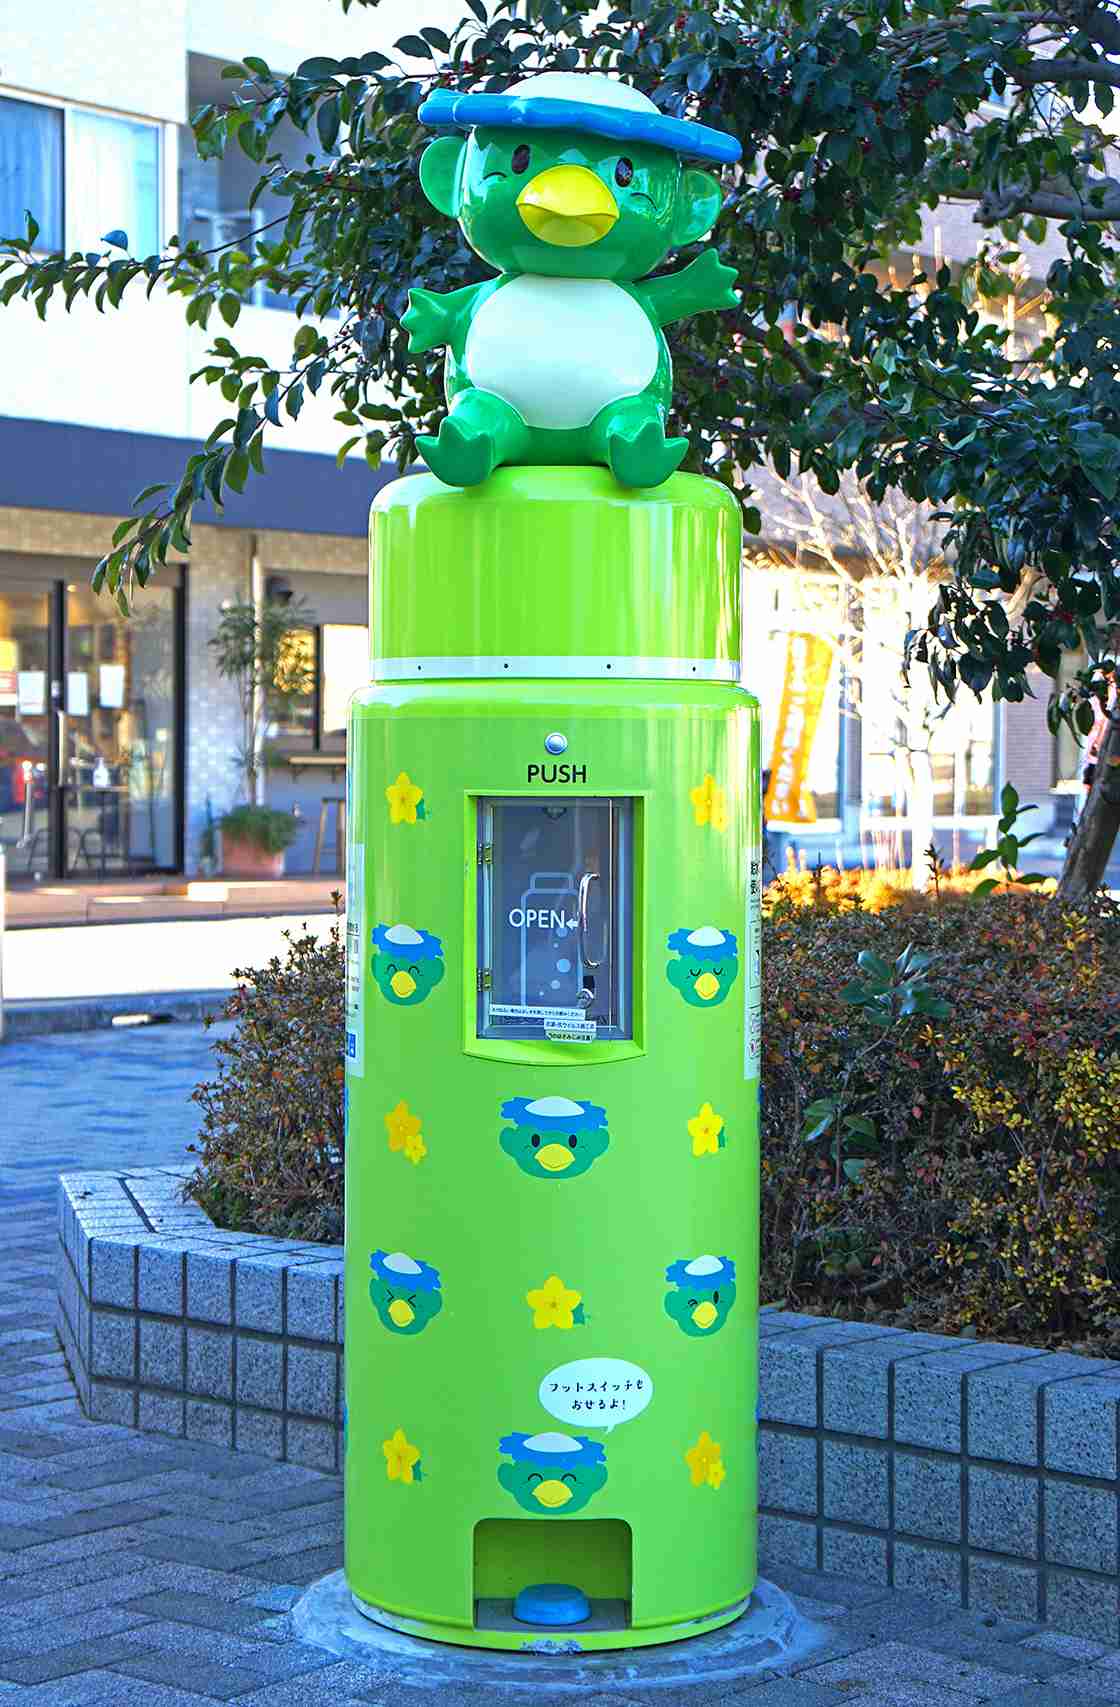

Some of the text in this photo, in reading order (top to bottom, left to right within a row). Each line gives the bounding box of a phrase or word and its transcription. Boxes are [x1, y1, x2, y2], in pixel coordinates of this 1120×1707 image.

[528, 764, 587, 783] PUSH
[509, 908, 566, 929] OPEN
[549, 1380, 643, 1392] フットスイッチも
